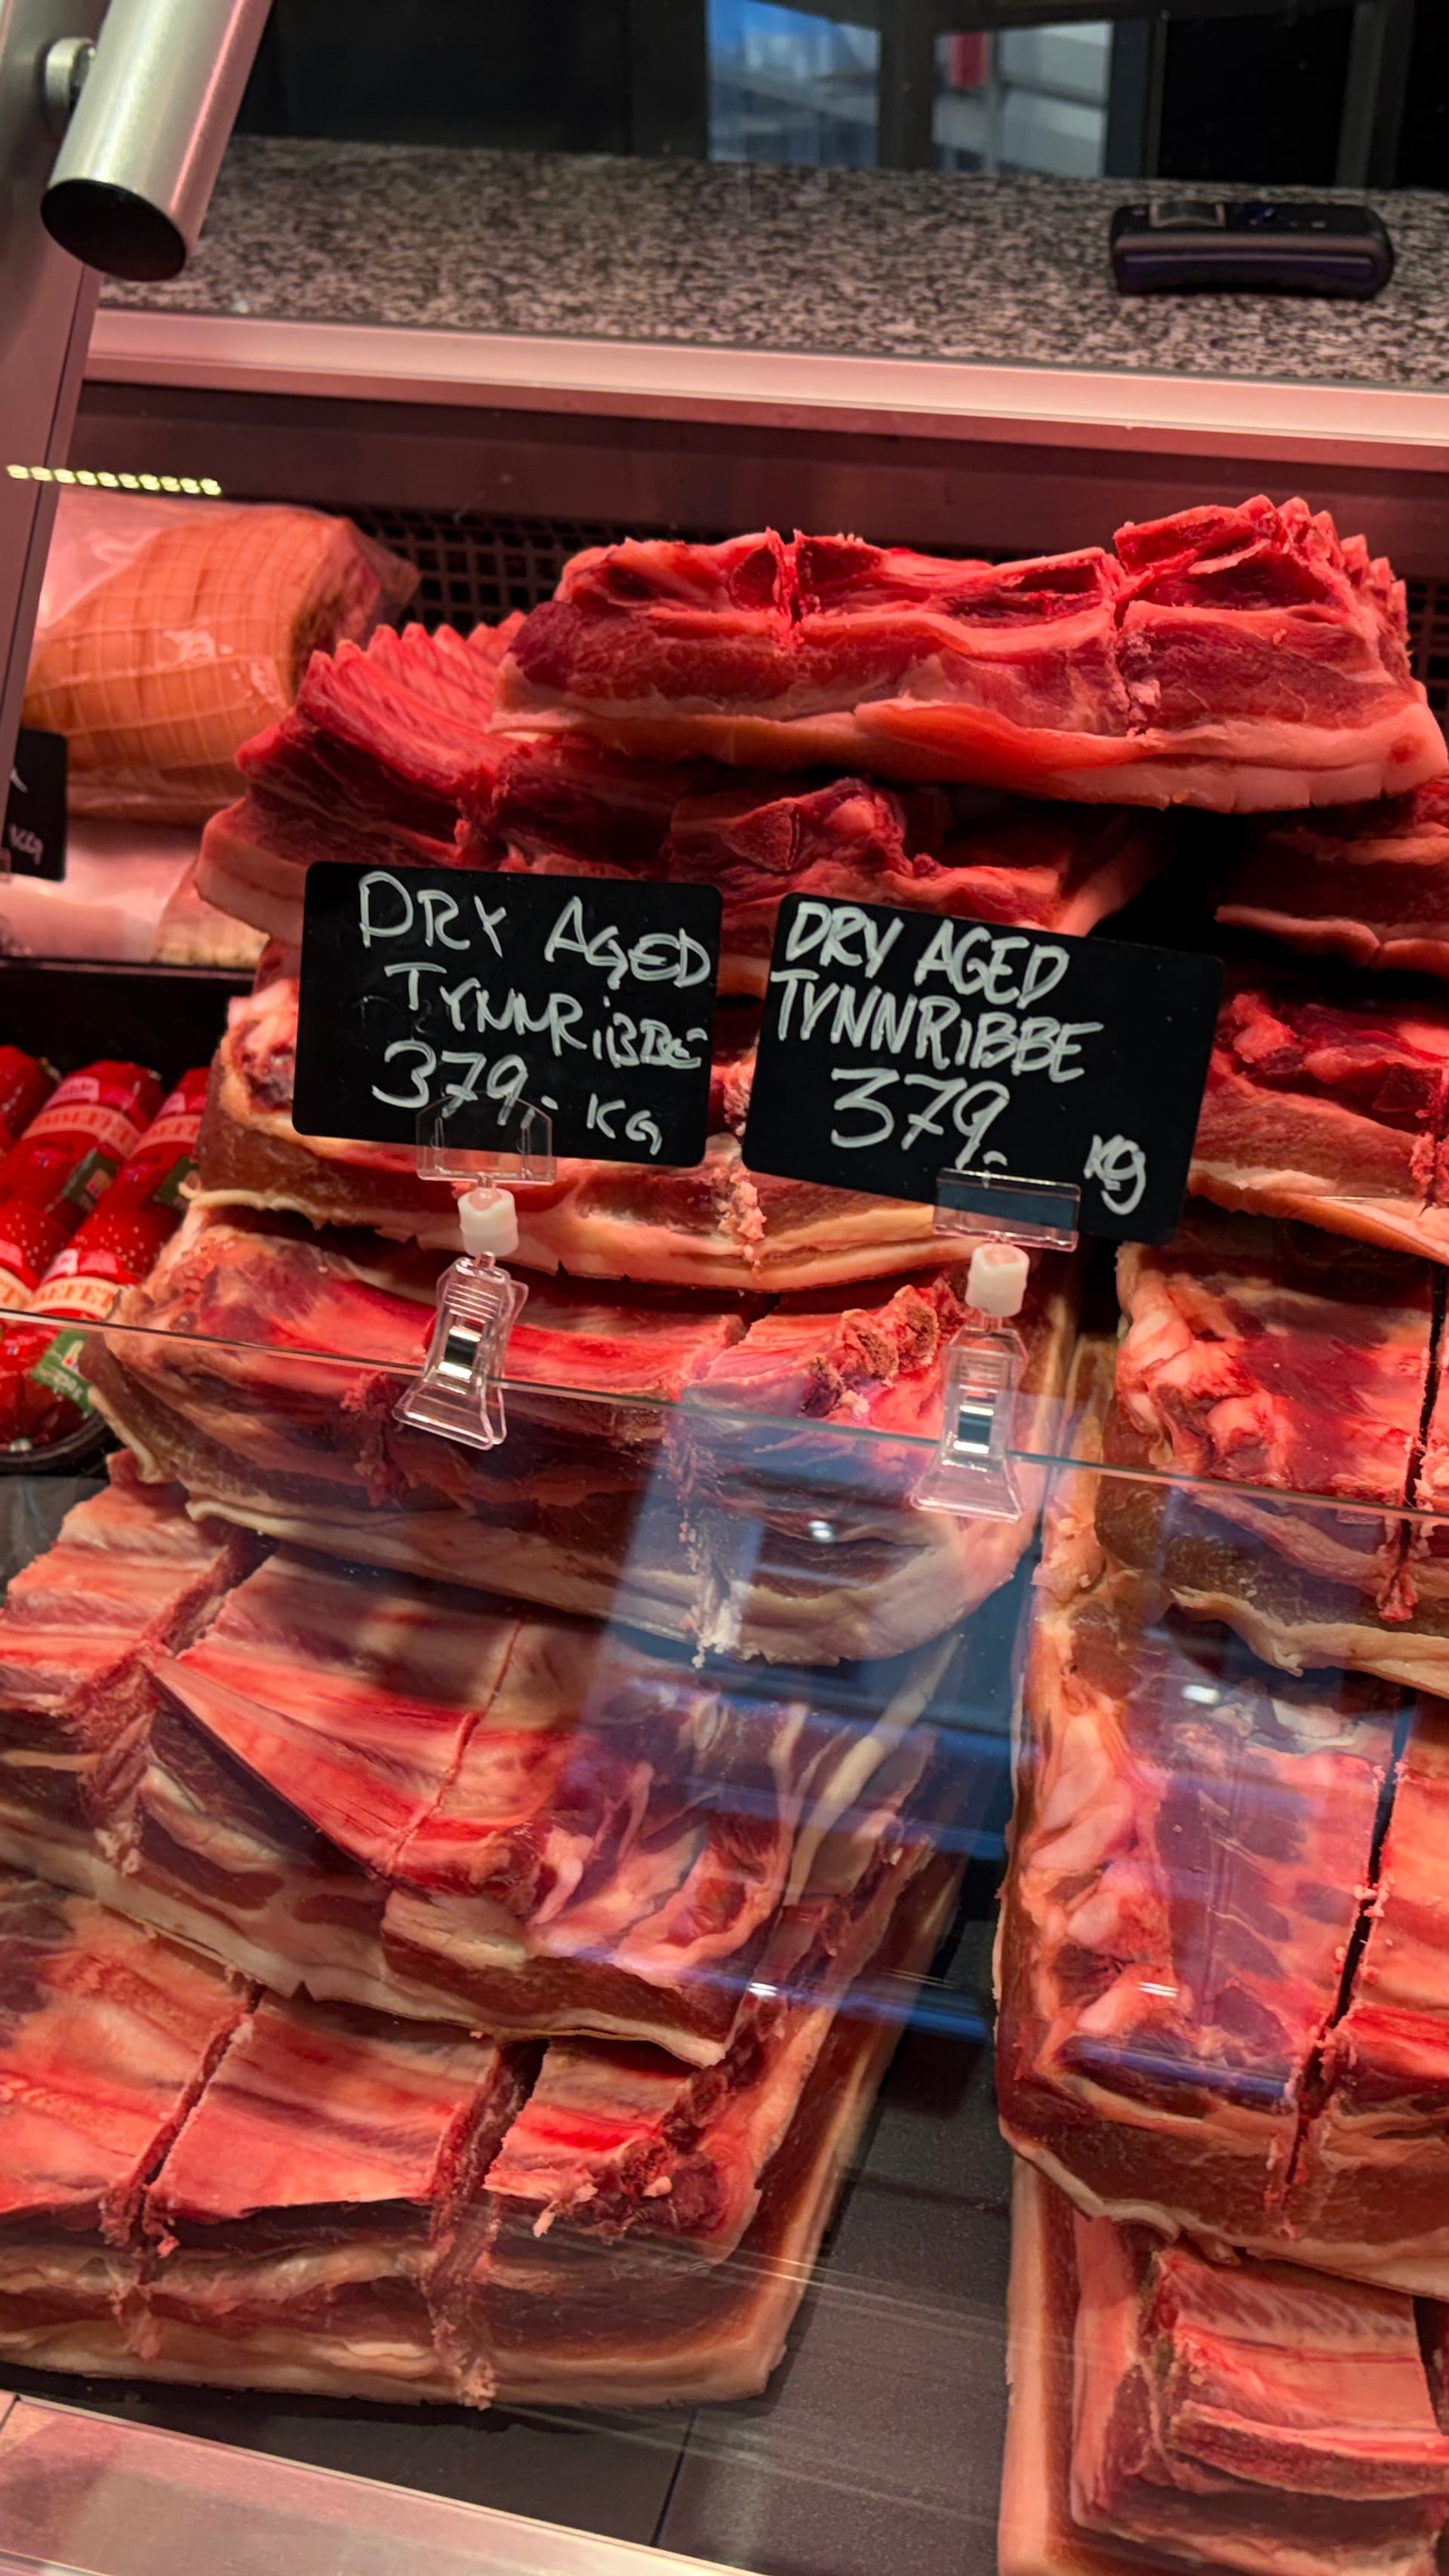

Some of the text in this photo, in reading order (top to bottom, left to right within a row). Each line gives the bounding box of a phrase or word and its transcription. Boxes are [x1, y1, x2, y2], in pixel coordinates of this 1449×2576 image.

[358, 871, 711, 989] DRY AGED
[786, 901, 1069, 1009] DRY AGED
